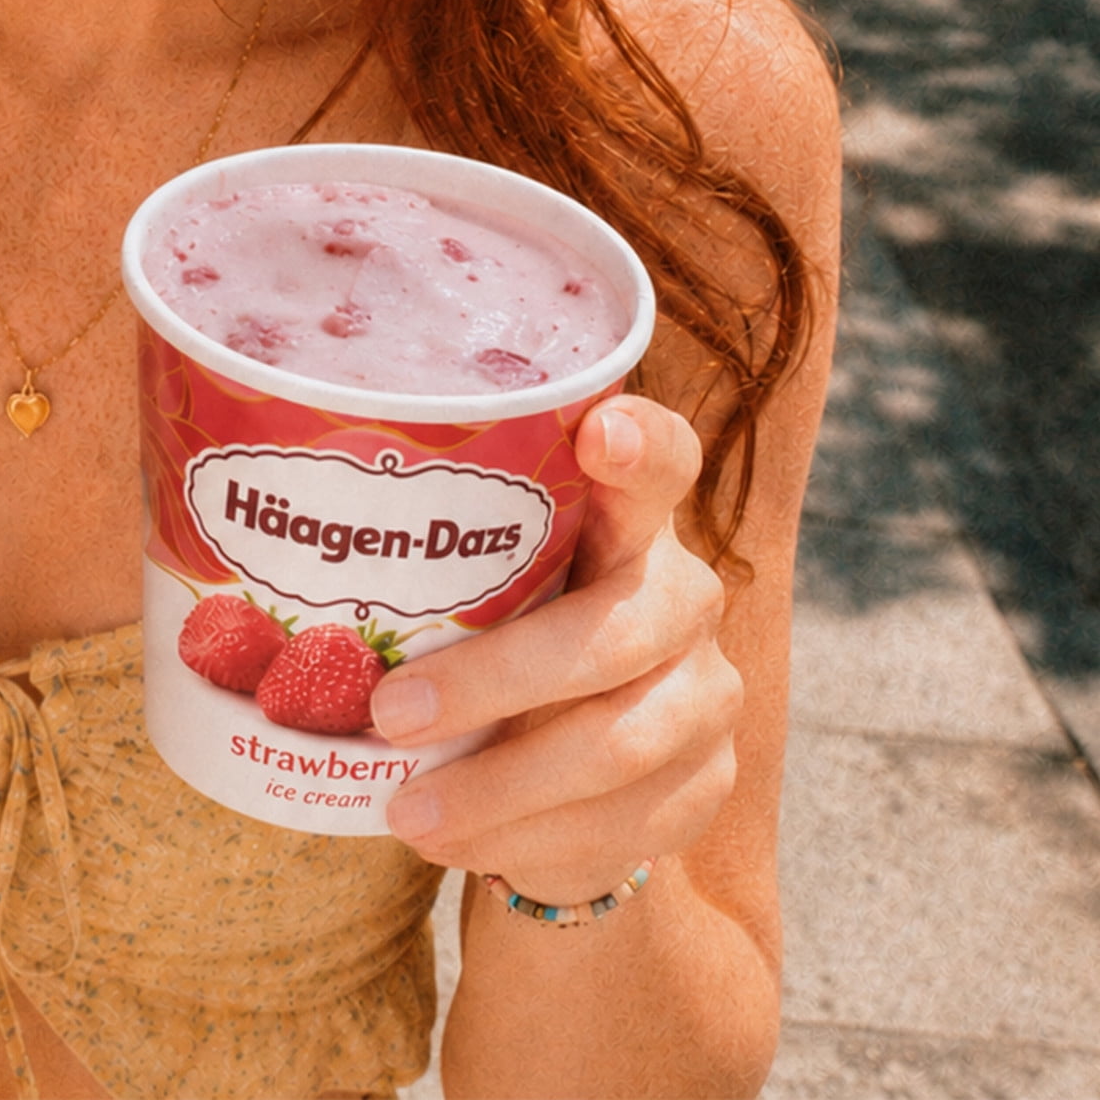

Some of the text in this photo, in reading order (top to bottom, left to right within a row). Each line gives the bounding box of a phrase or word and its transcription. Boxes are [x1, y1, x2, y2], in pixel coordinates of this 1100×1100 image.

[224, 479, 522, 563] Häagen-Dazs
[230, 734, 419, 785] strawberry
[264, 778, 372, 808] ice cream
